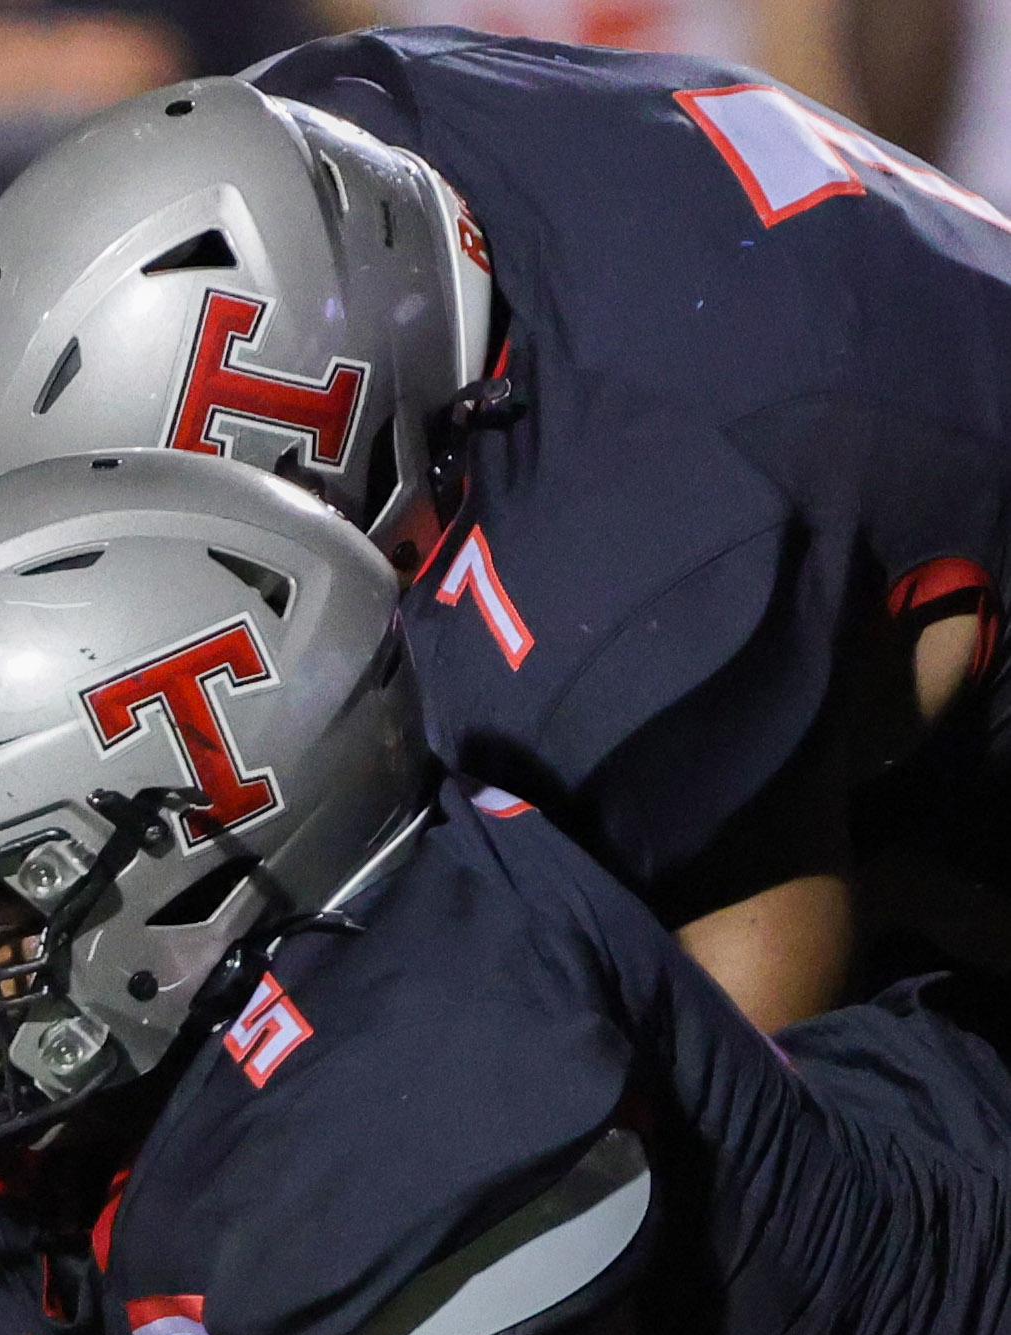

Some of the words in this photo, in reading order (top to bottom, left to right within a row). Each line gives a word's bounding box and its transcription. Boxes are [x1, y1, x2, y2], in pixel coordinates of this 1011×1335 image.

[157, 287, 371, 473] T
[435, 525, 535, 672] 7
[78, 611, 286, 856] T
[223, 971, 314, 1089] 5
